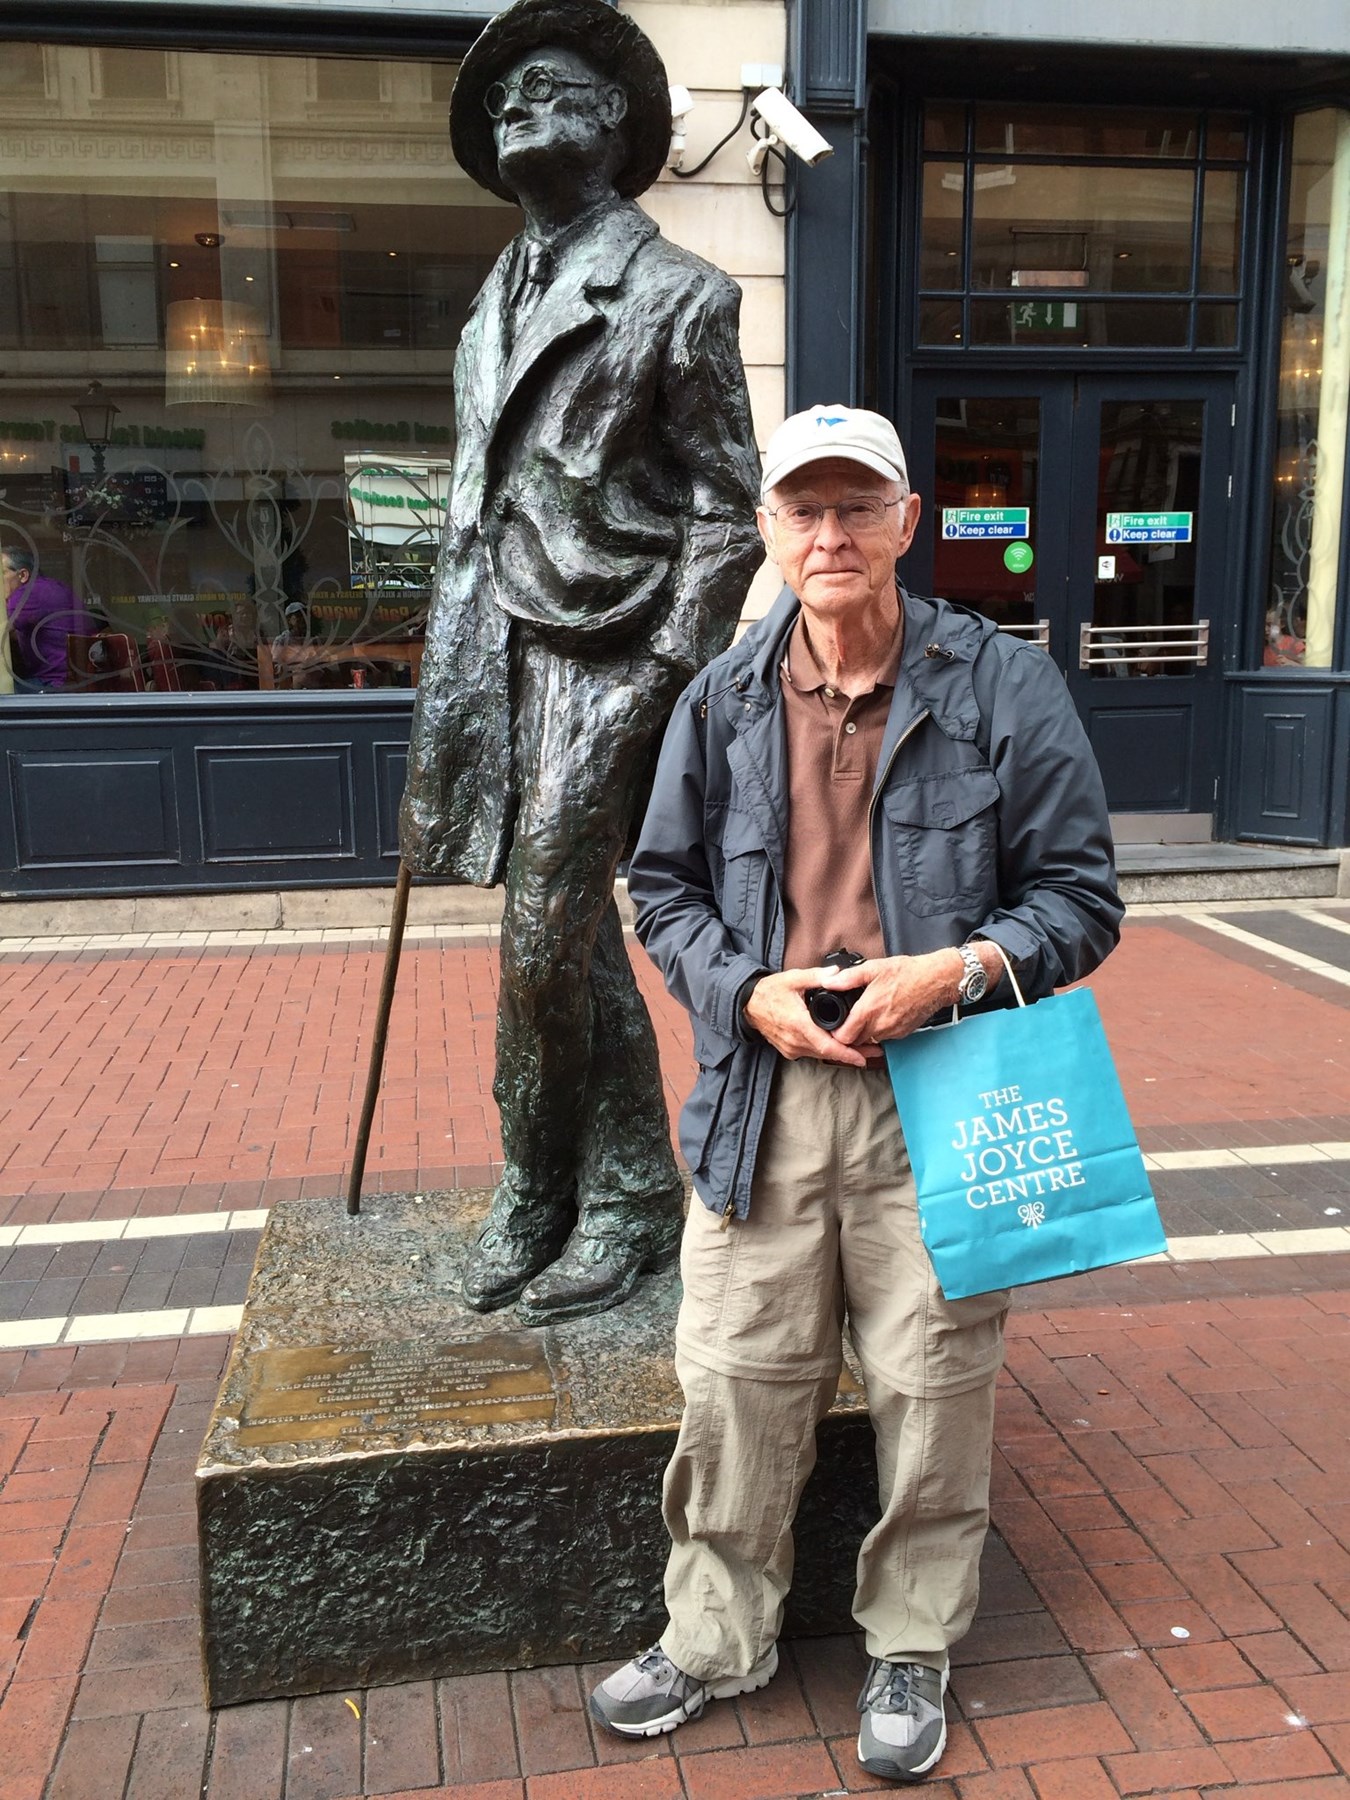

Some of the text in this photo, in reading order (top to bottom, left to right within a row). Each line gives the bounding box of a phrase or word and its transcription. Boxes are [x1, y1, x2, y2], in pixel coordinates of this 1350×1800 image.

[960, 511, 1004, 522] Fire exit
[1123, 516, 1168, 526] Fire exit
[960, 525, 1013, 536] Keep clear
[1123, 530, 1177, 540] Keep clear
[978, 1085, 1022, 1109] THE
[952, 1098, 1068, 1150] JAMES
[960, 1130, 1078, 1182] JOYCE
[966, 1162, 1085, 1209] CENTRE
